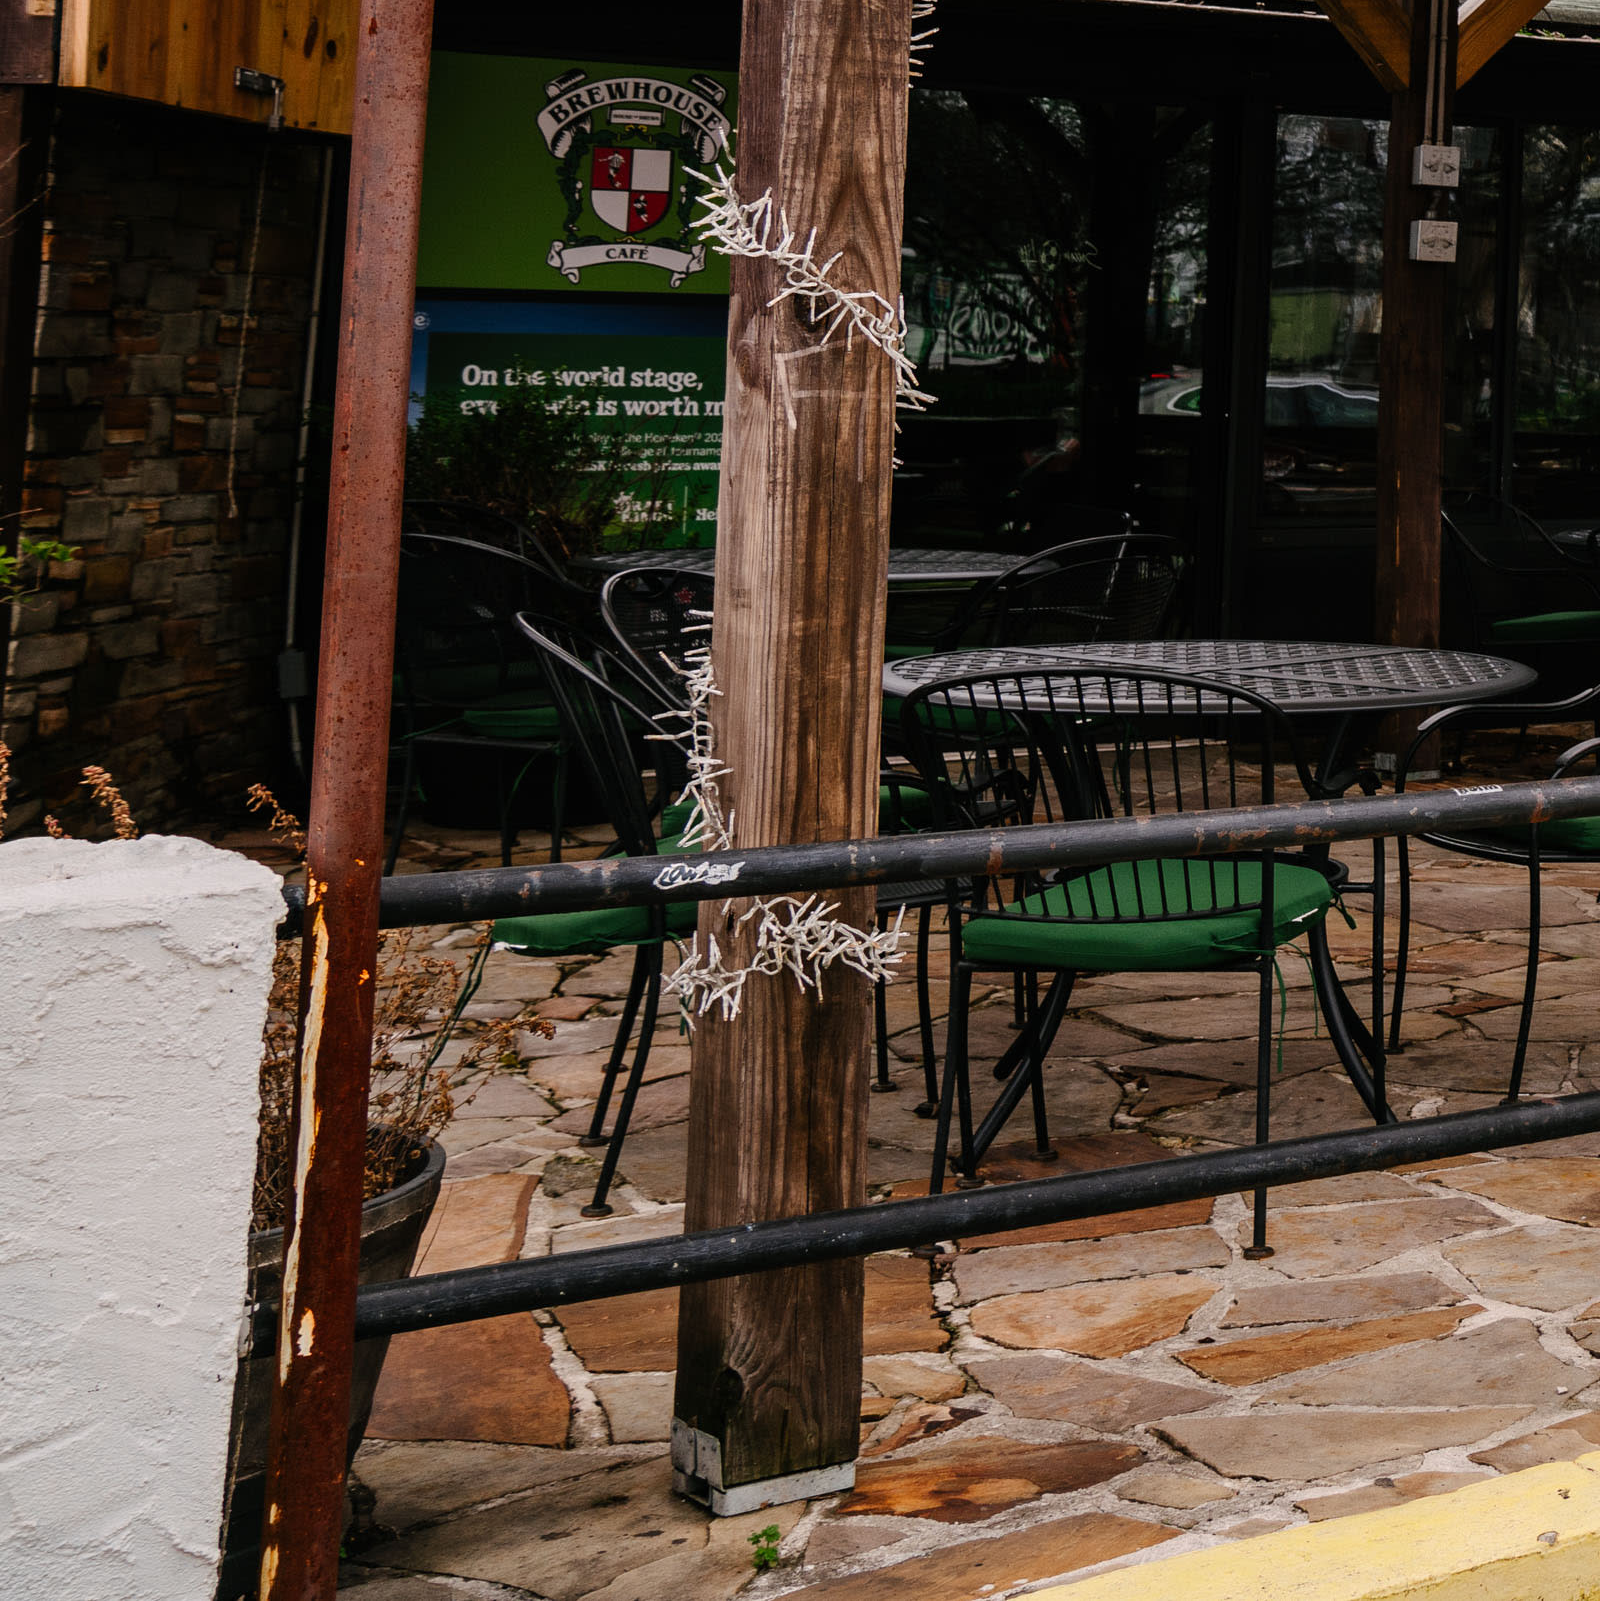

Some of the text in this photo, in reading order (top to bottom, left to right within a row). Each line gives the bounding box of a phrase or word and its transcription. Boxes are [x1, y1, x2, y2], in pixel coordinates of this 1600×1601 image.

[548, 81, 722, 131] BREWHOUSE
[605, 245, 649, 260] CAFÉ
[461, 365, 498, 387] On
[552, 366, 626, 388] world
[630, 368, 704, 393] stage,
[595, 397, 619, 417] is
[622, 396, 700, 417] worth
